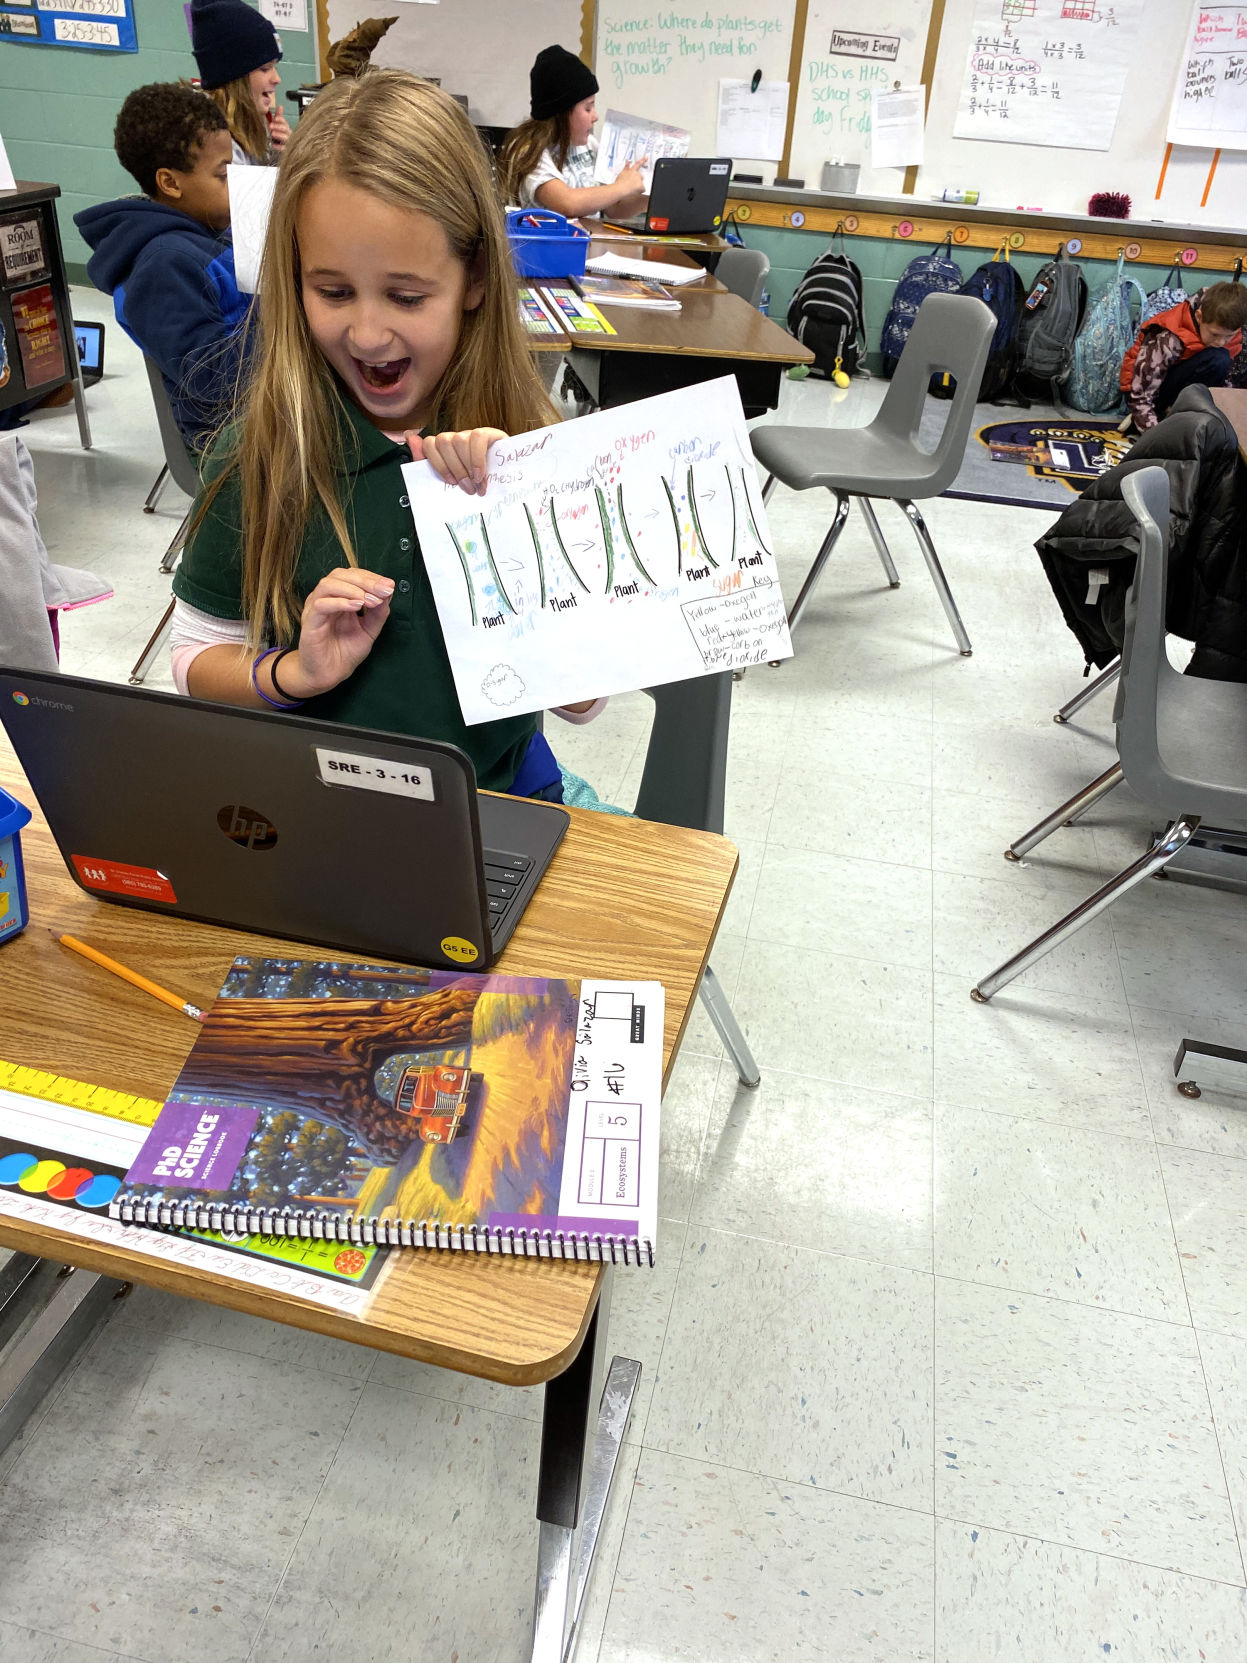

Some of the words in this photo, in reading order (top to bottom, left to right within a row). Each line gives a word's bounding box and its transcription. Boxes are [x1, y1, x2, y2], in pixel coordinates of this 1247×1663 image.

[657, 11, 698, 30] Where
[700, 11, 714, 28] do
[717, 10, 757, 37] plants
[758, 18, 785, 40] get
[604, 37, 622, 56] the
[626, 37, 671, 56] matter
[678, 33, 706, 63] they
[708, 38, 734, 56] need
[737, 36, 758, 57] for
[831, 33, 869, 53] Upcoming
[872, 39, 898, 54] Events
[611, 56, 673, 90] growth?
[808, 61, 839, 83] DHS
[842, 68, 855, 79] vs
[860, 63, 890, 83] HHS
[977, 58, 995, 72] Add
[811, 84, 850, 105] school
[7, 228, 34, 245] ROOM
[738, 550, 764, 570] Plant
[685, 565, 712, 582] Plant
[751, 575, 774, 589] Key
[613, 580, 640, 598] Plant
[549, 591, 578, 613] Plant
[481, 610, 506, 629] Plant
[30, 696, 75, 713] chrome
[327, 760, 362, 776] SRE
[375, 768, 386, 780] 3
[400, 773, 421, 786] 16
[229, 804, 269, 850] hp
[442, 942, 458, 953] G5
[460, 947, 477, 956] EE
[575, 998, 596, 1046] Salazar
[570, 1055, 591, 1093] Olivia
[602, 1062, 626, 1096] #16
[606, 1115, 628, 1127] 5
[151, 1146, 183, 1177] PhD
[200, 1157, 217, 1180] SCIENCE
[211, 1131, 228, 1157] LOGBOOK
[615, 1146, 628, 1199] Ecosystems
